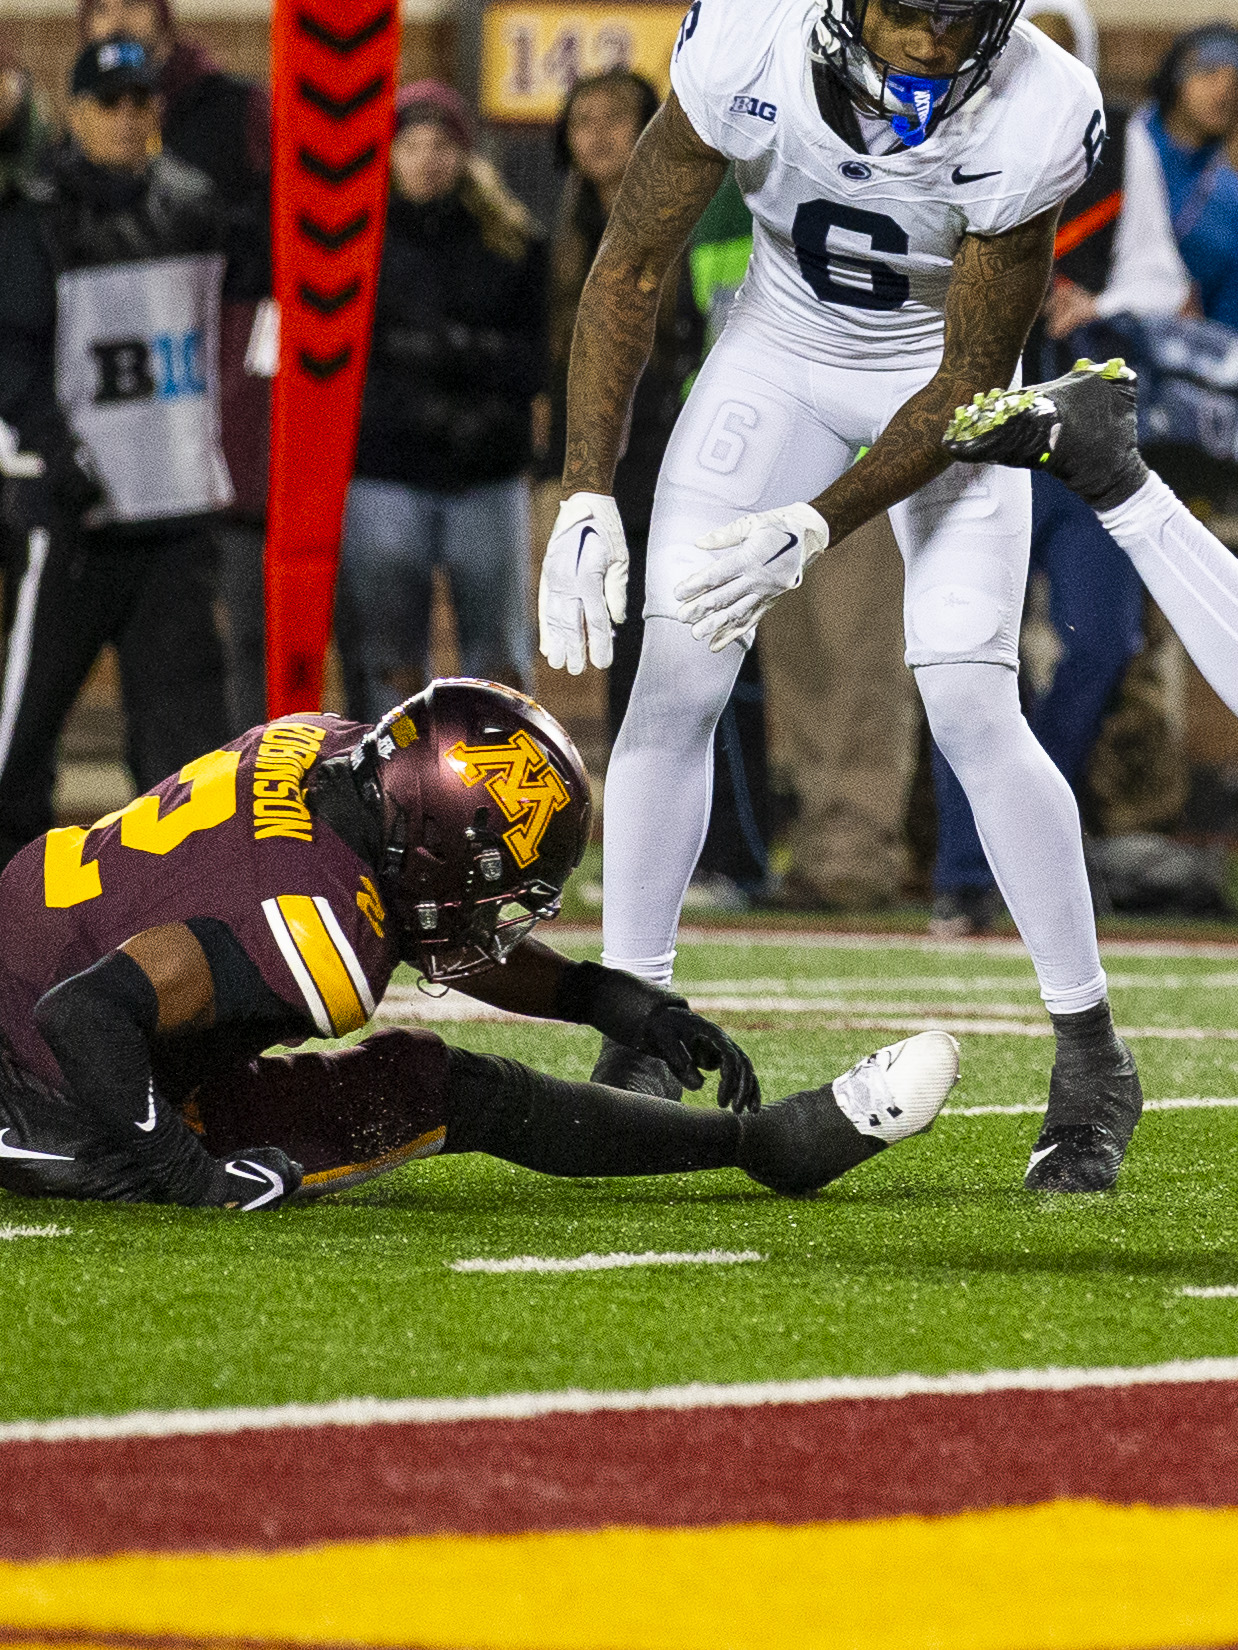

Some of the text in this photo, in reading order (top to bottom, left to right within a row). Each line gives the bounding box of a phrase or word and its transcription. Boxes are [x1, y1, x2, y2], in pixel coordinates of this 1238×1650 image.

[792, 199, 910, 310] 6
[698, 399, 758, 475] 6
[253, 721, 327, 842] ROBINSON
